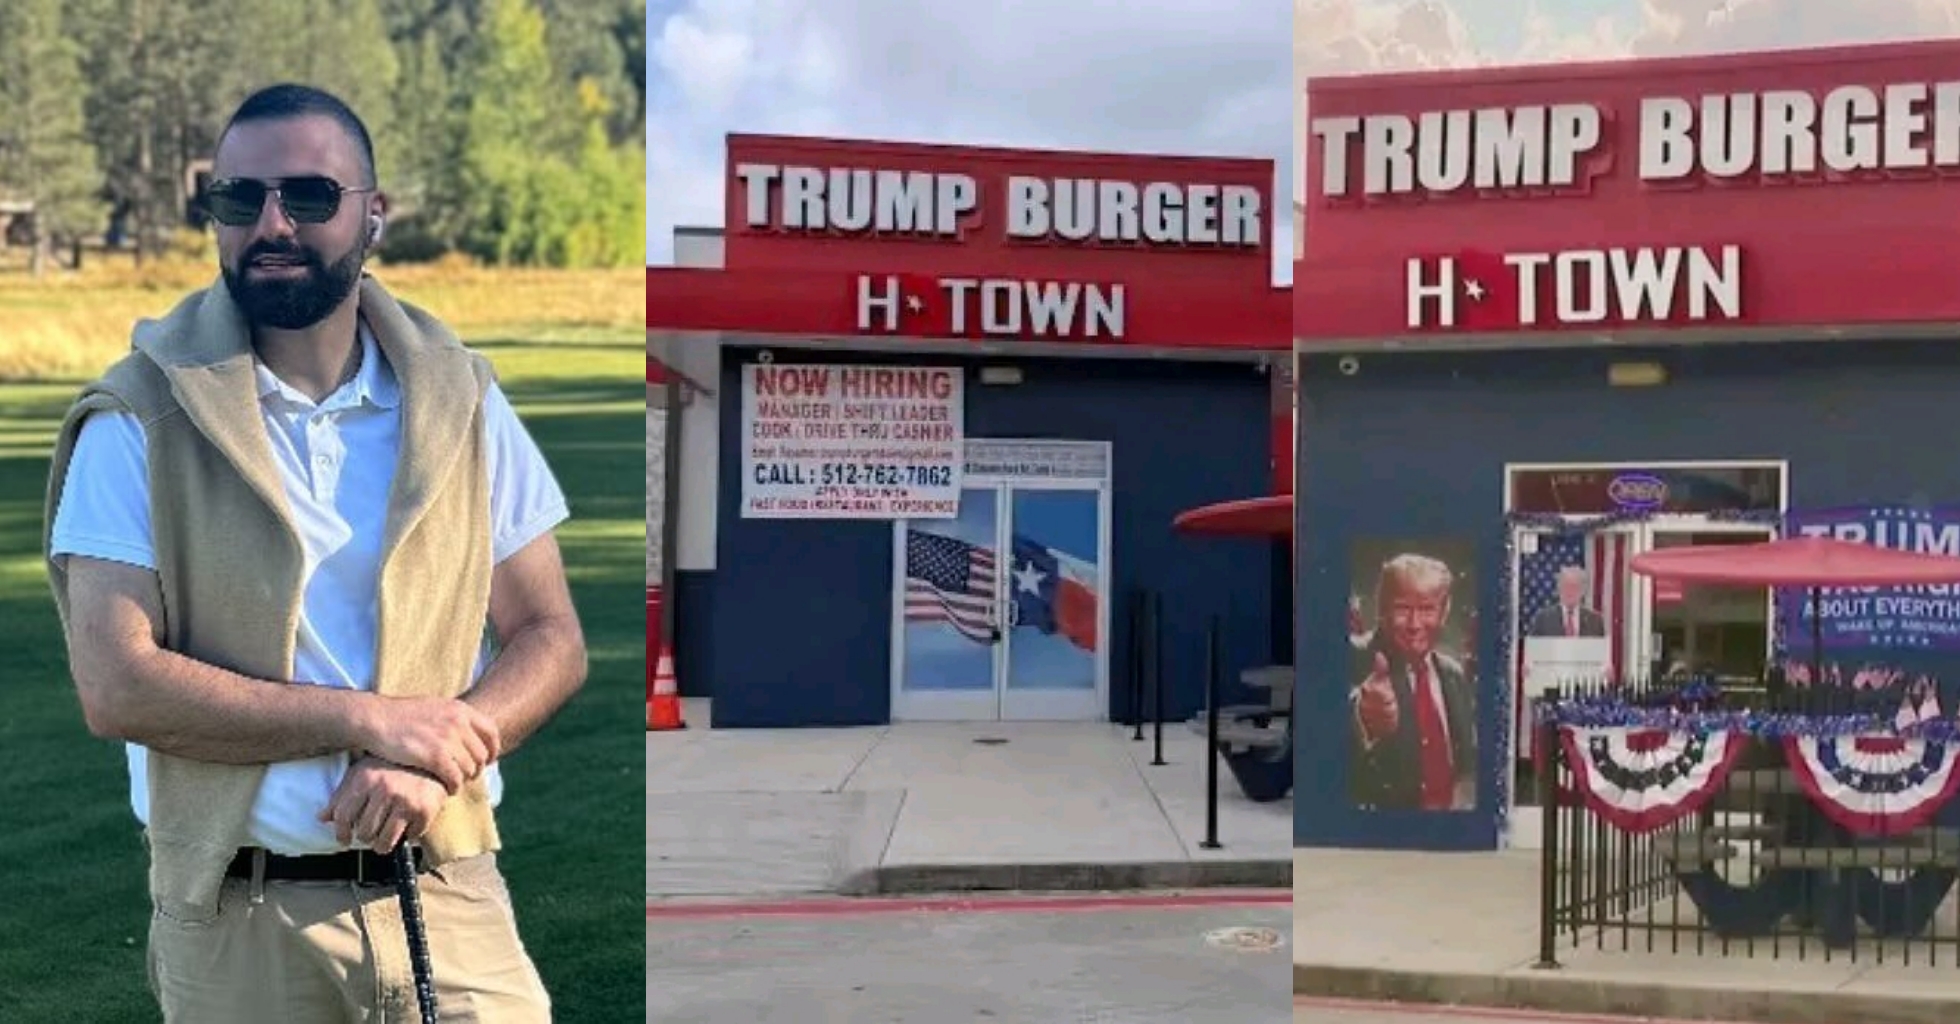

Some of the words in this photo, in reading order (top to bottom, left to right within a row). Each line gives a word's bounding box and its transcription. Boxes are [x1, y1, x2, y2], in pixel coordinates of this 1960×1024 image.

[1312, 104, 1600, 196] TRUMP
[736, 163, 977, 235] TRUMP
[1007, 176, 1260, 246] BURGER
[1504, 245, 1740, 324] TOWN
[939, 279, 1124, 338] TOWN
[755, 367, 828, 396] NOW
[841, 369, 951, 399] HIRING
[752, 422, 790, 438] COOK
[804, 423, 847, 439] DRIVE
[894, 424, 954, 441] CASHIER
[758, 403, 831, 419] MANAGER
[844, 403, 887, 420] SHIFT
[892, 404, 948, 421] LEADER
[1802, 597, 1870, 620] ABOUT
